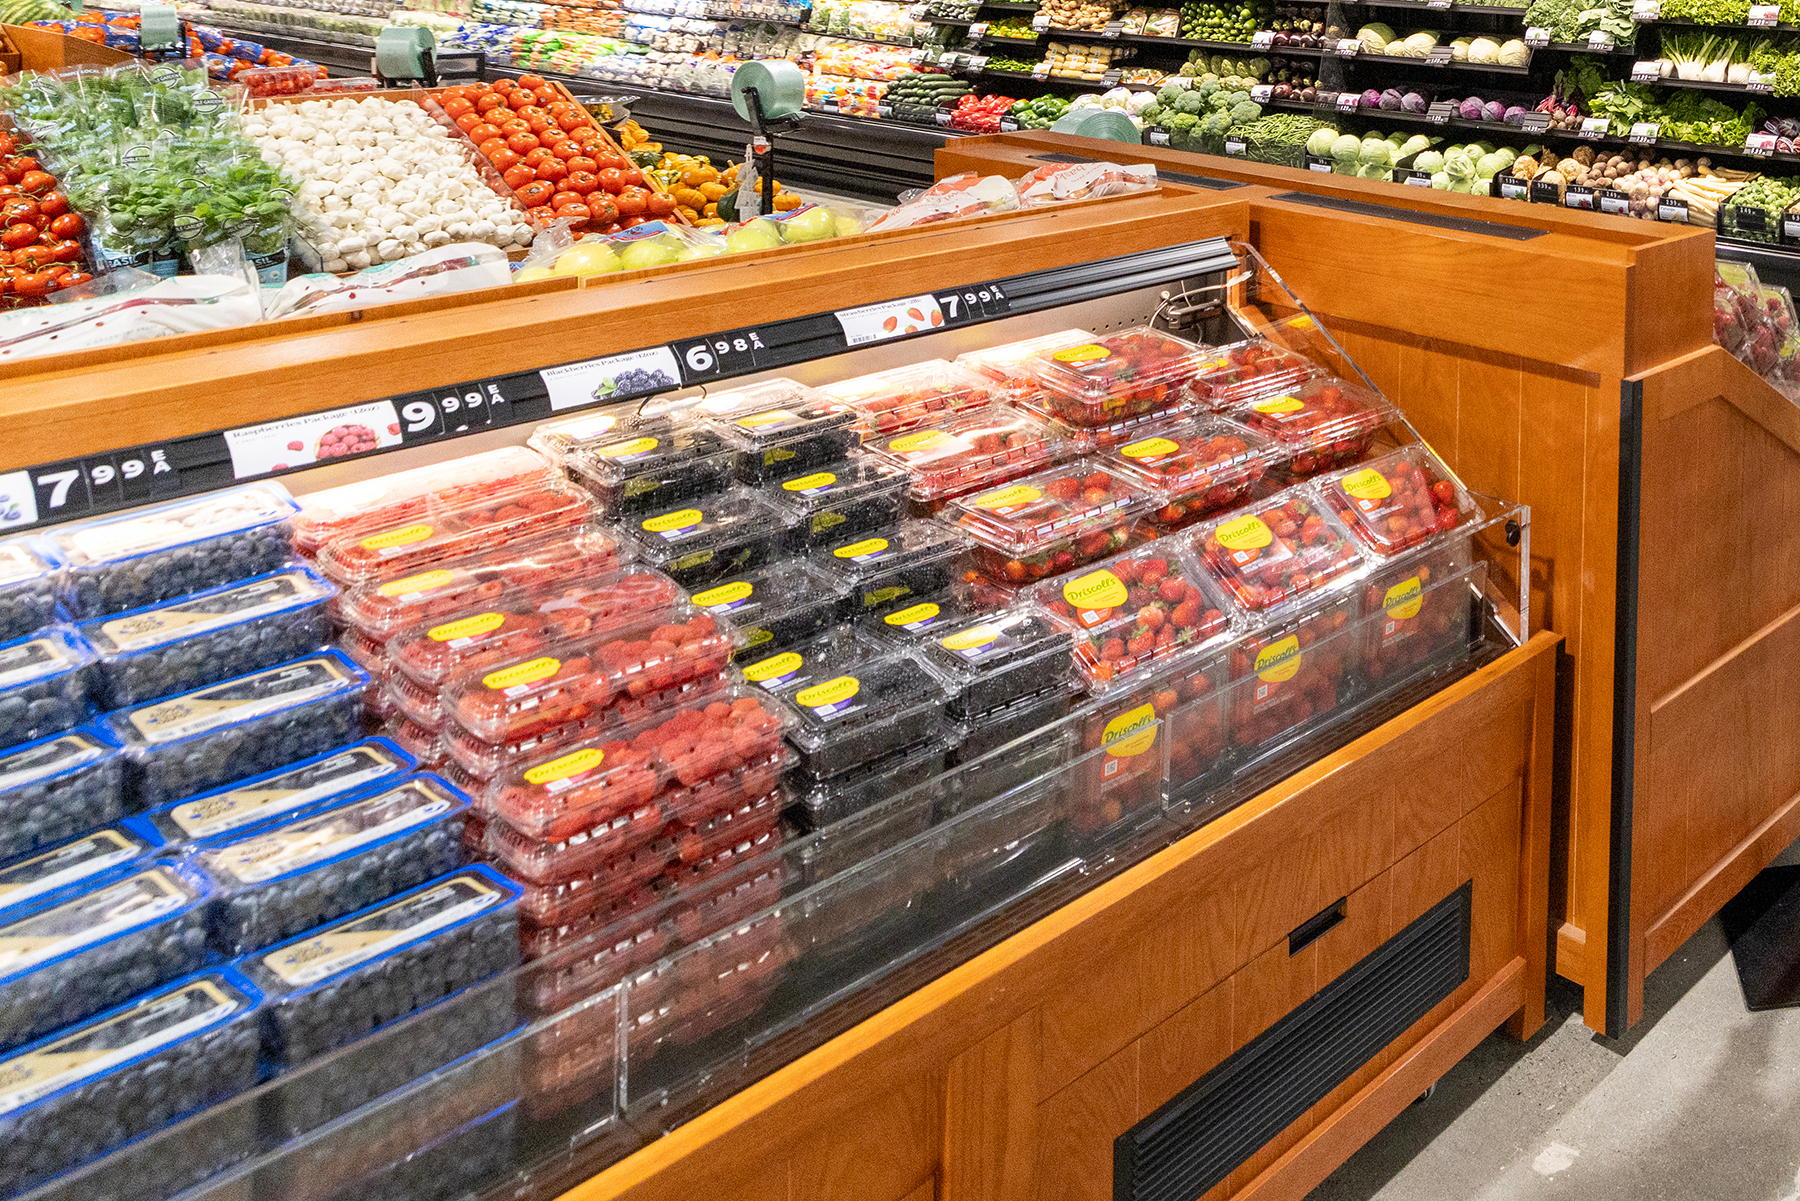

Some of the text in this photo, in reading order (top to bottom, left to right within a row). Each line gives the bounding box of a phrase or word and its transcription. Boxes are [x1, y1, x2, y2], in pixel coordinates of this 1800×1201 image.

[839, 301, 907, 319] Strawberries Package
[546, 361, 601, 376] Blackberries
[601, 354, 635, 366] Package
[233, 420, 302, 439] Raspberries
[303, 411, 349, 425] Package
[1128, 440, 1172, 455] Driscoll's
[1345, 475, 1381, 493] Driscoll's
[646, 509, 700, 530] Driscoll's
[1218, 520, 1262, 543] Driscoll's
[840, 540, 886, 557] Driscoll's
[1067, 576, 1117, 601] Driscoll's
[1385, 583, 1421, 610] Driscoll's
[889, 603, 937, 623] Driscoll's
[747, 655, 799, 679] Driscoll's
[1256, 645, 1299, 671] Driscoll's
[802, 679, 855, 703] Driscoll's
[1105, 714, 1154, 745] Driscoll's
